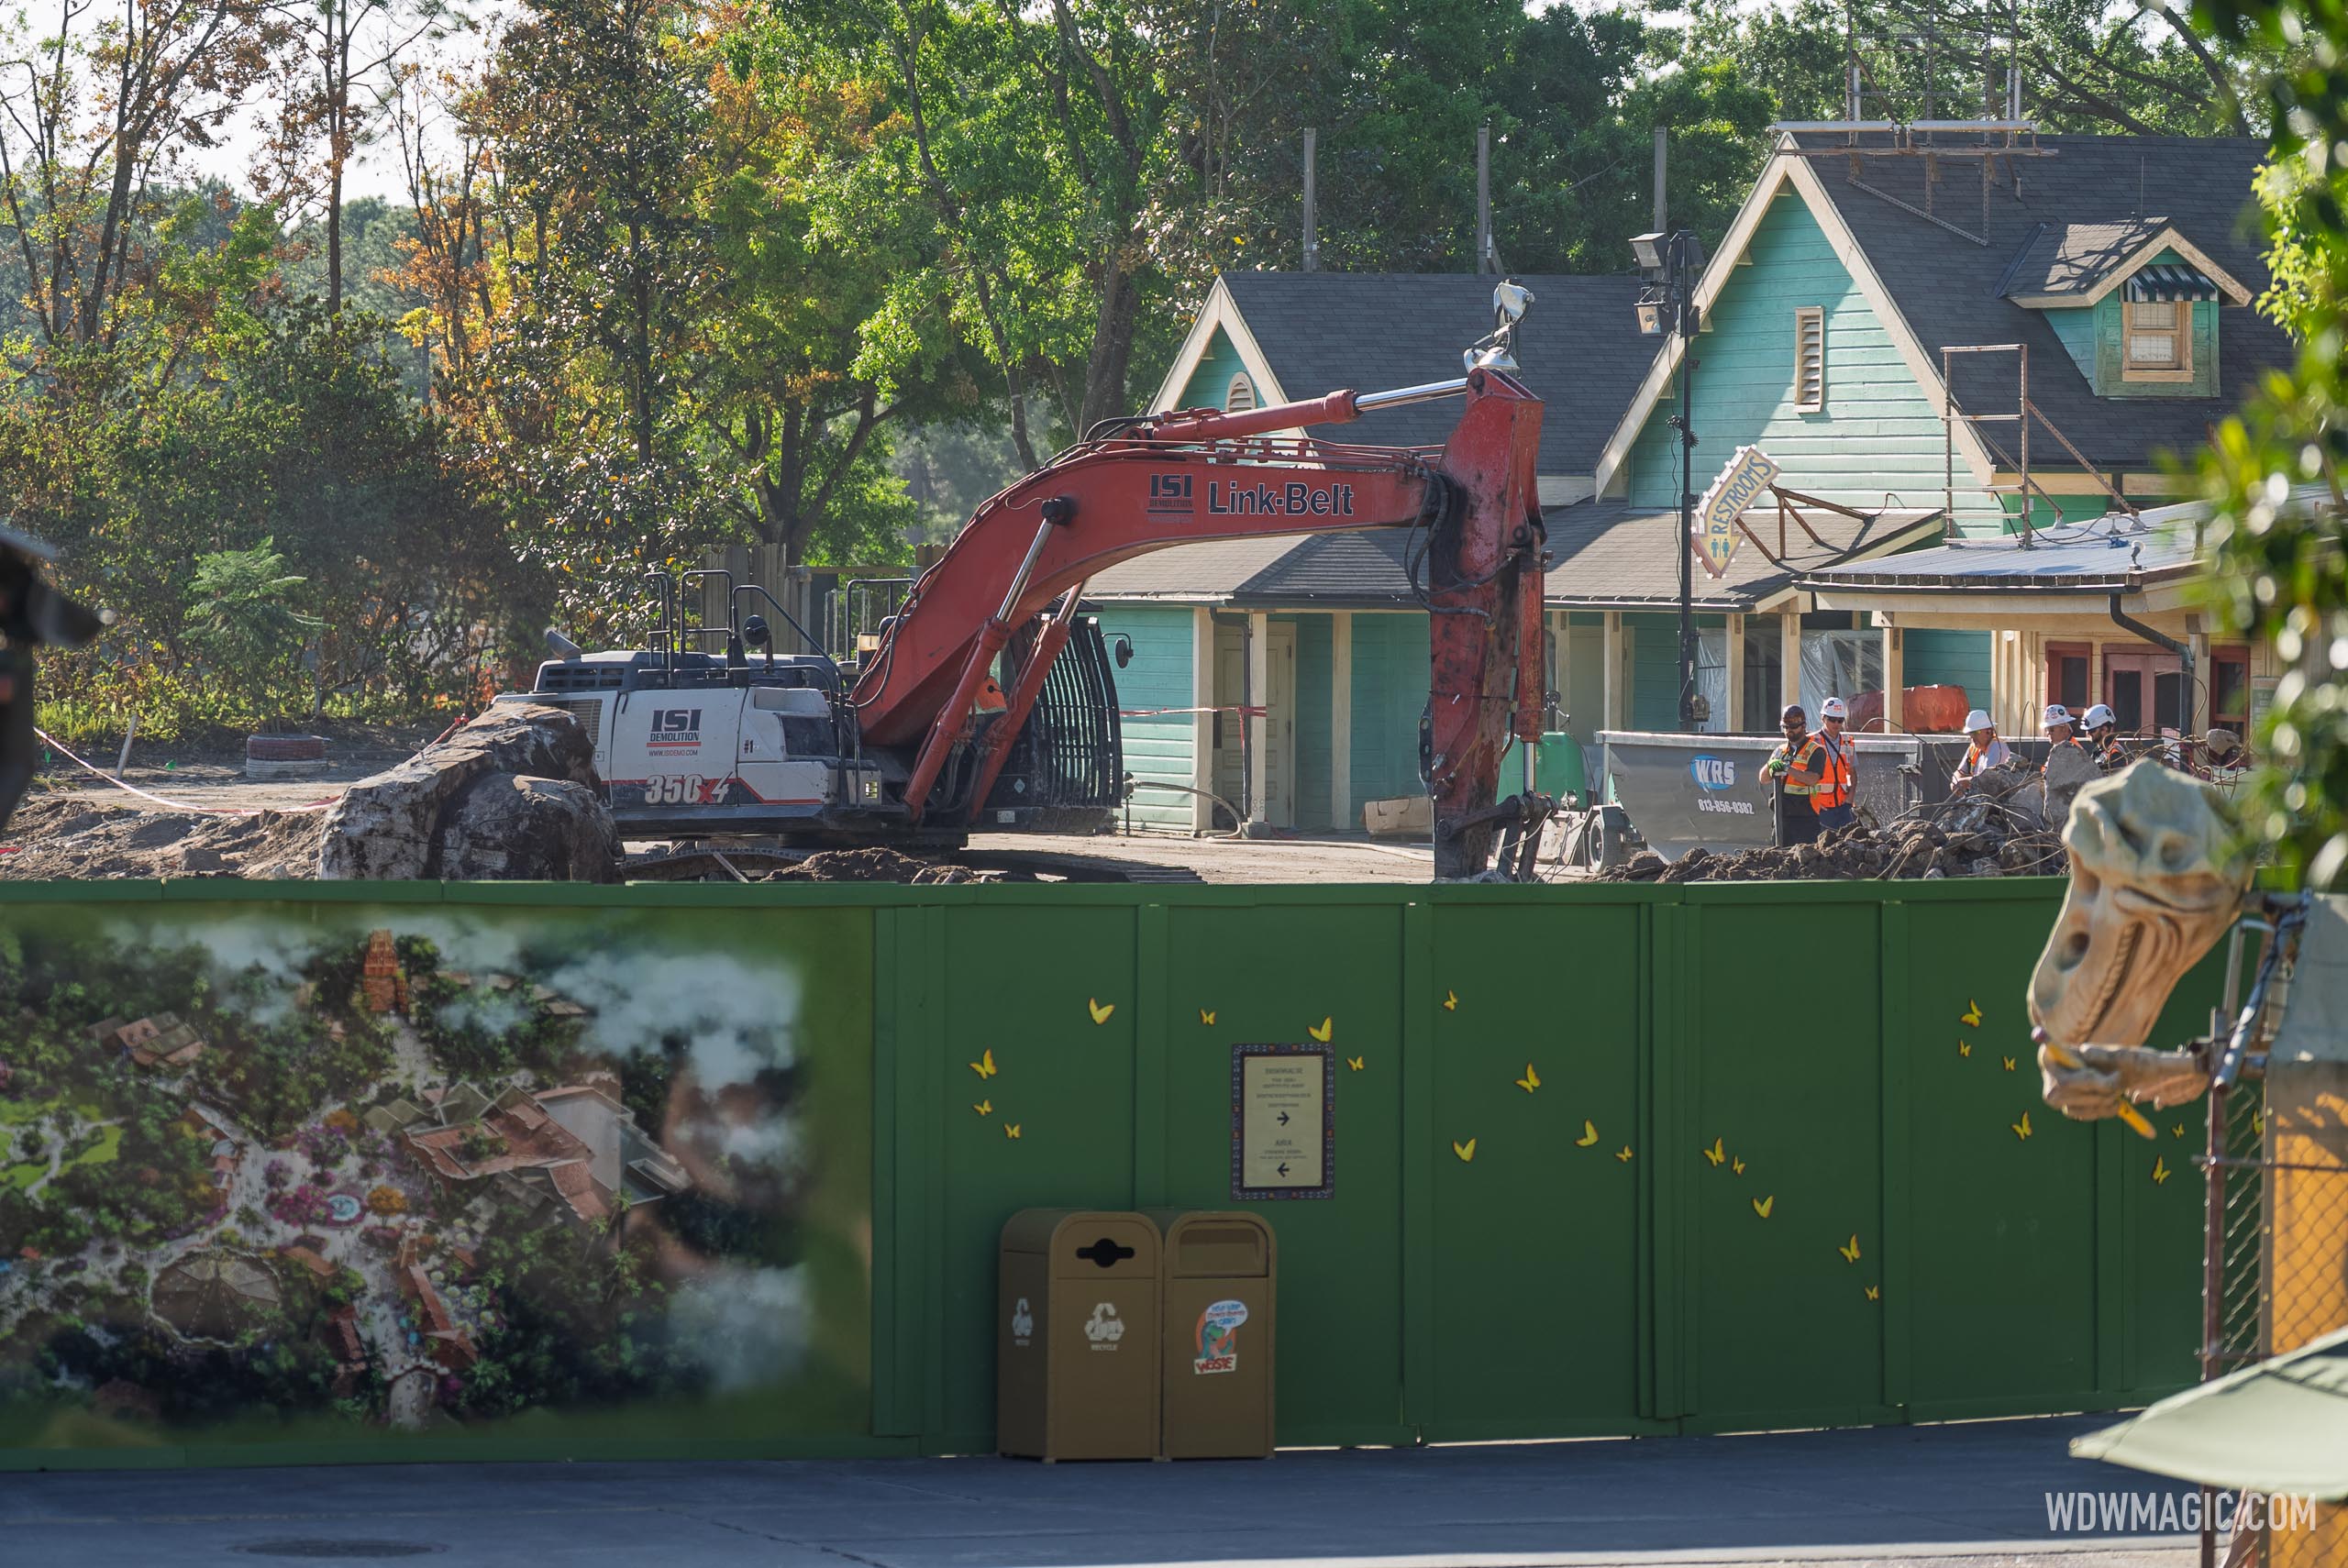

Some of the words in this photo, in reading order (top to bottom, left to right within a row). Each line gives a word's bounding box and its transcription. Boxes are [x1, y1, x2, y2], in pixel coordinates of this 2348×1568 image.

[1149, 474, 1193, 498] ISI
[1208, 480, 1354, 515] Link-Belt
[1711, 456, 1772, 535] RESTROOMS
[651, 710, 702, 732] ISI
[649, 732, 700, 742] DEMOLITION
[1696, 759, 1735, 786] WRS
